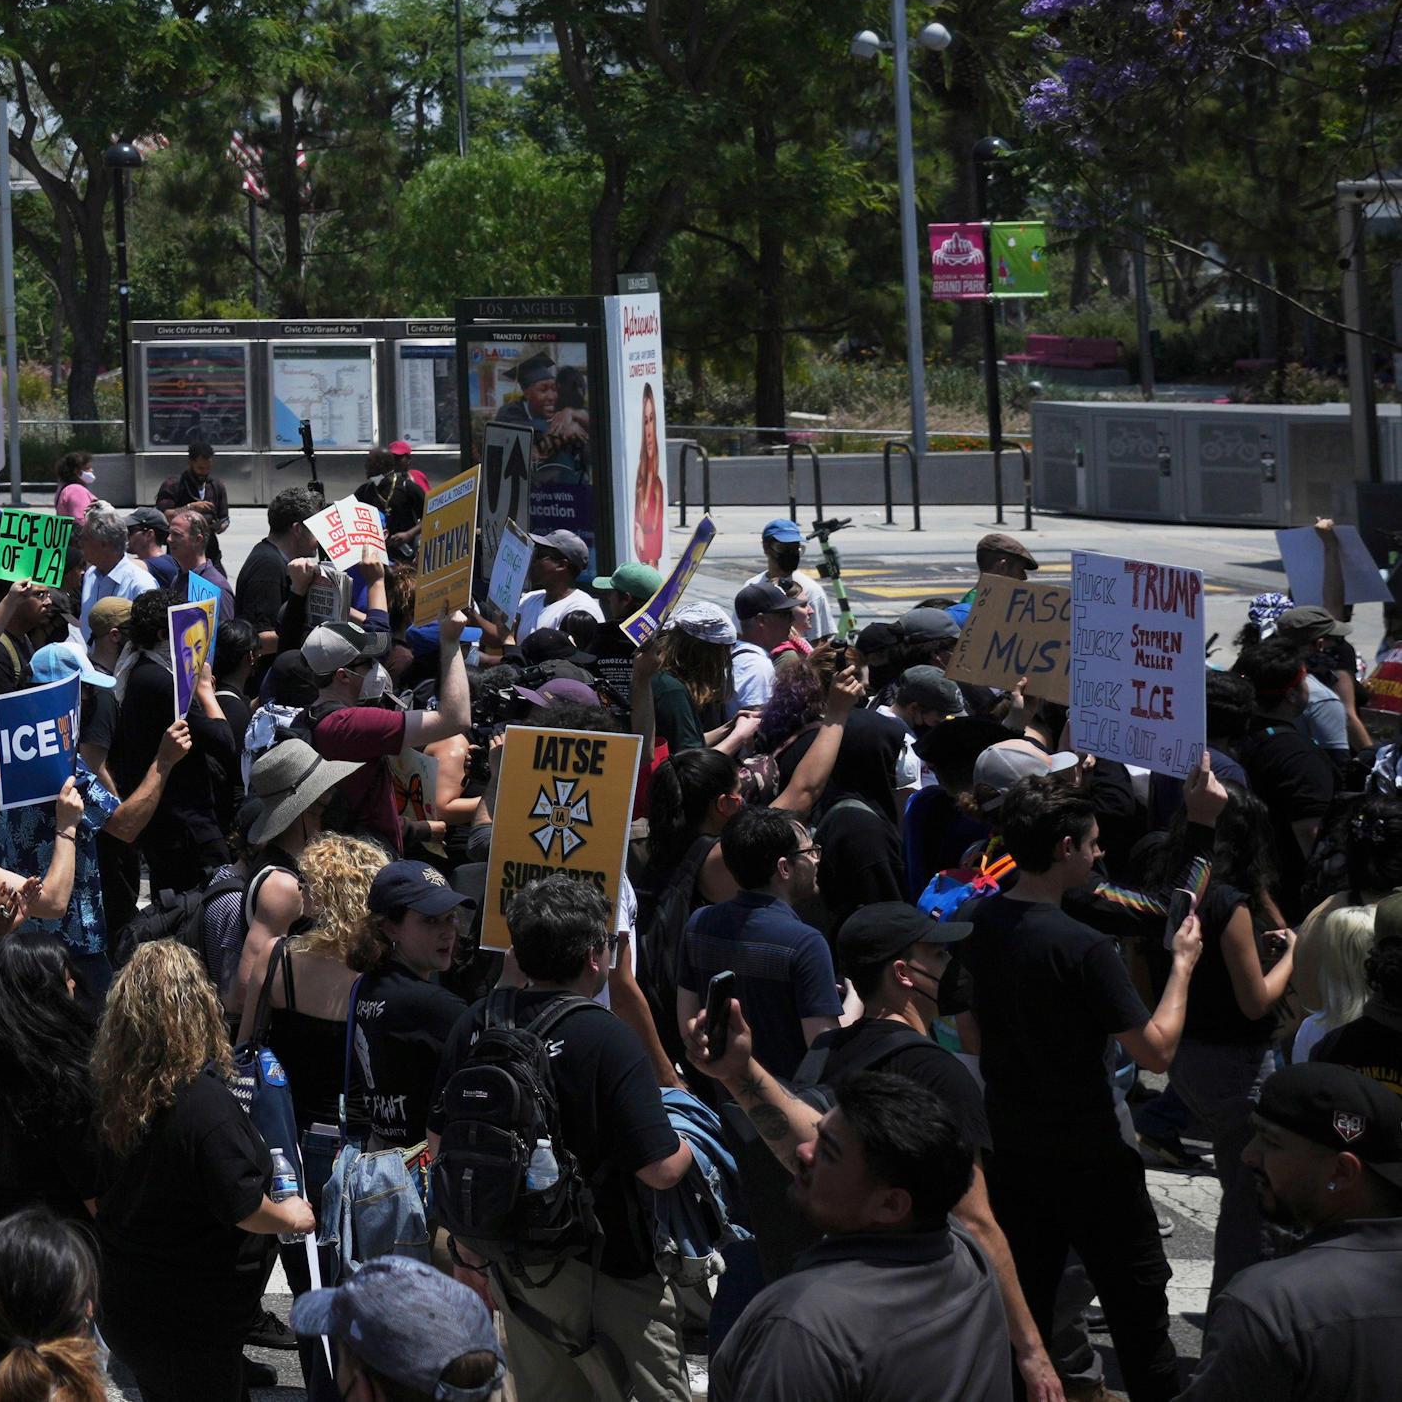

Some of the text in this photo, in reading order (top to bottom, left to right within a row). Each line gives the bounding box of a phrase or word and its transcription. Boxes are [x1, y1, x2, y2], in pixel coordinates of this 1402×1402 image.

[932, 279, 986, 293] GRAND PARK
[478, 302, 576, 316] LOS ANGELES
[157, 326, 231, 335] Civic Ctr/Grand Park
[284, 325, 358, 335] Civic Ctr/Grand Park
[410, 325, 456, 334] Civic Ctr/Gra
[530, 492, 552, 502] egins
[530, 503, 575, 518] ucation
[358, 509, 372, 520] ICE
[0, 512, 74, 549] ICE OUT
[421, 520, 470, 577] NITHYA
[1, 544, 62, 585] OF LA
[1072, 553, 1201, 620] FUCK TRUMP
[1004, 588, 1072, 624] FASC
[1072, 604, 1183, 661] FUCK STEPHEN
[1134, 651, 1174, 671] MILLER
[1072, 659, 1175, 721] FUCK ICE
[0, 718, 60, 765] ICE
[1077, 710, 1120, 755] ICE
[1124, 724, 1157, 761] OUT
[532, 735, 608, 776] IATSE
[355, 999, 386, 1019] CRAFTS
